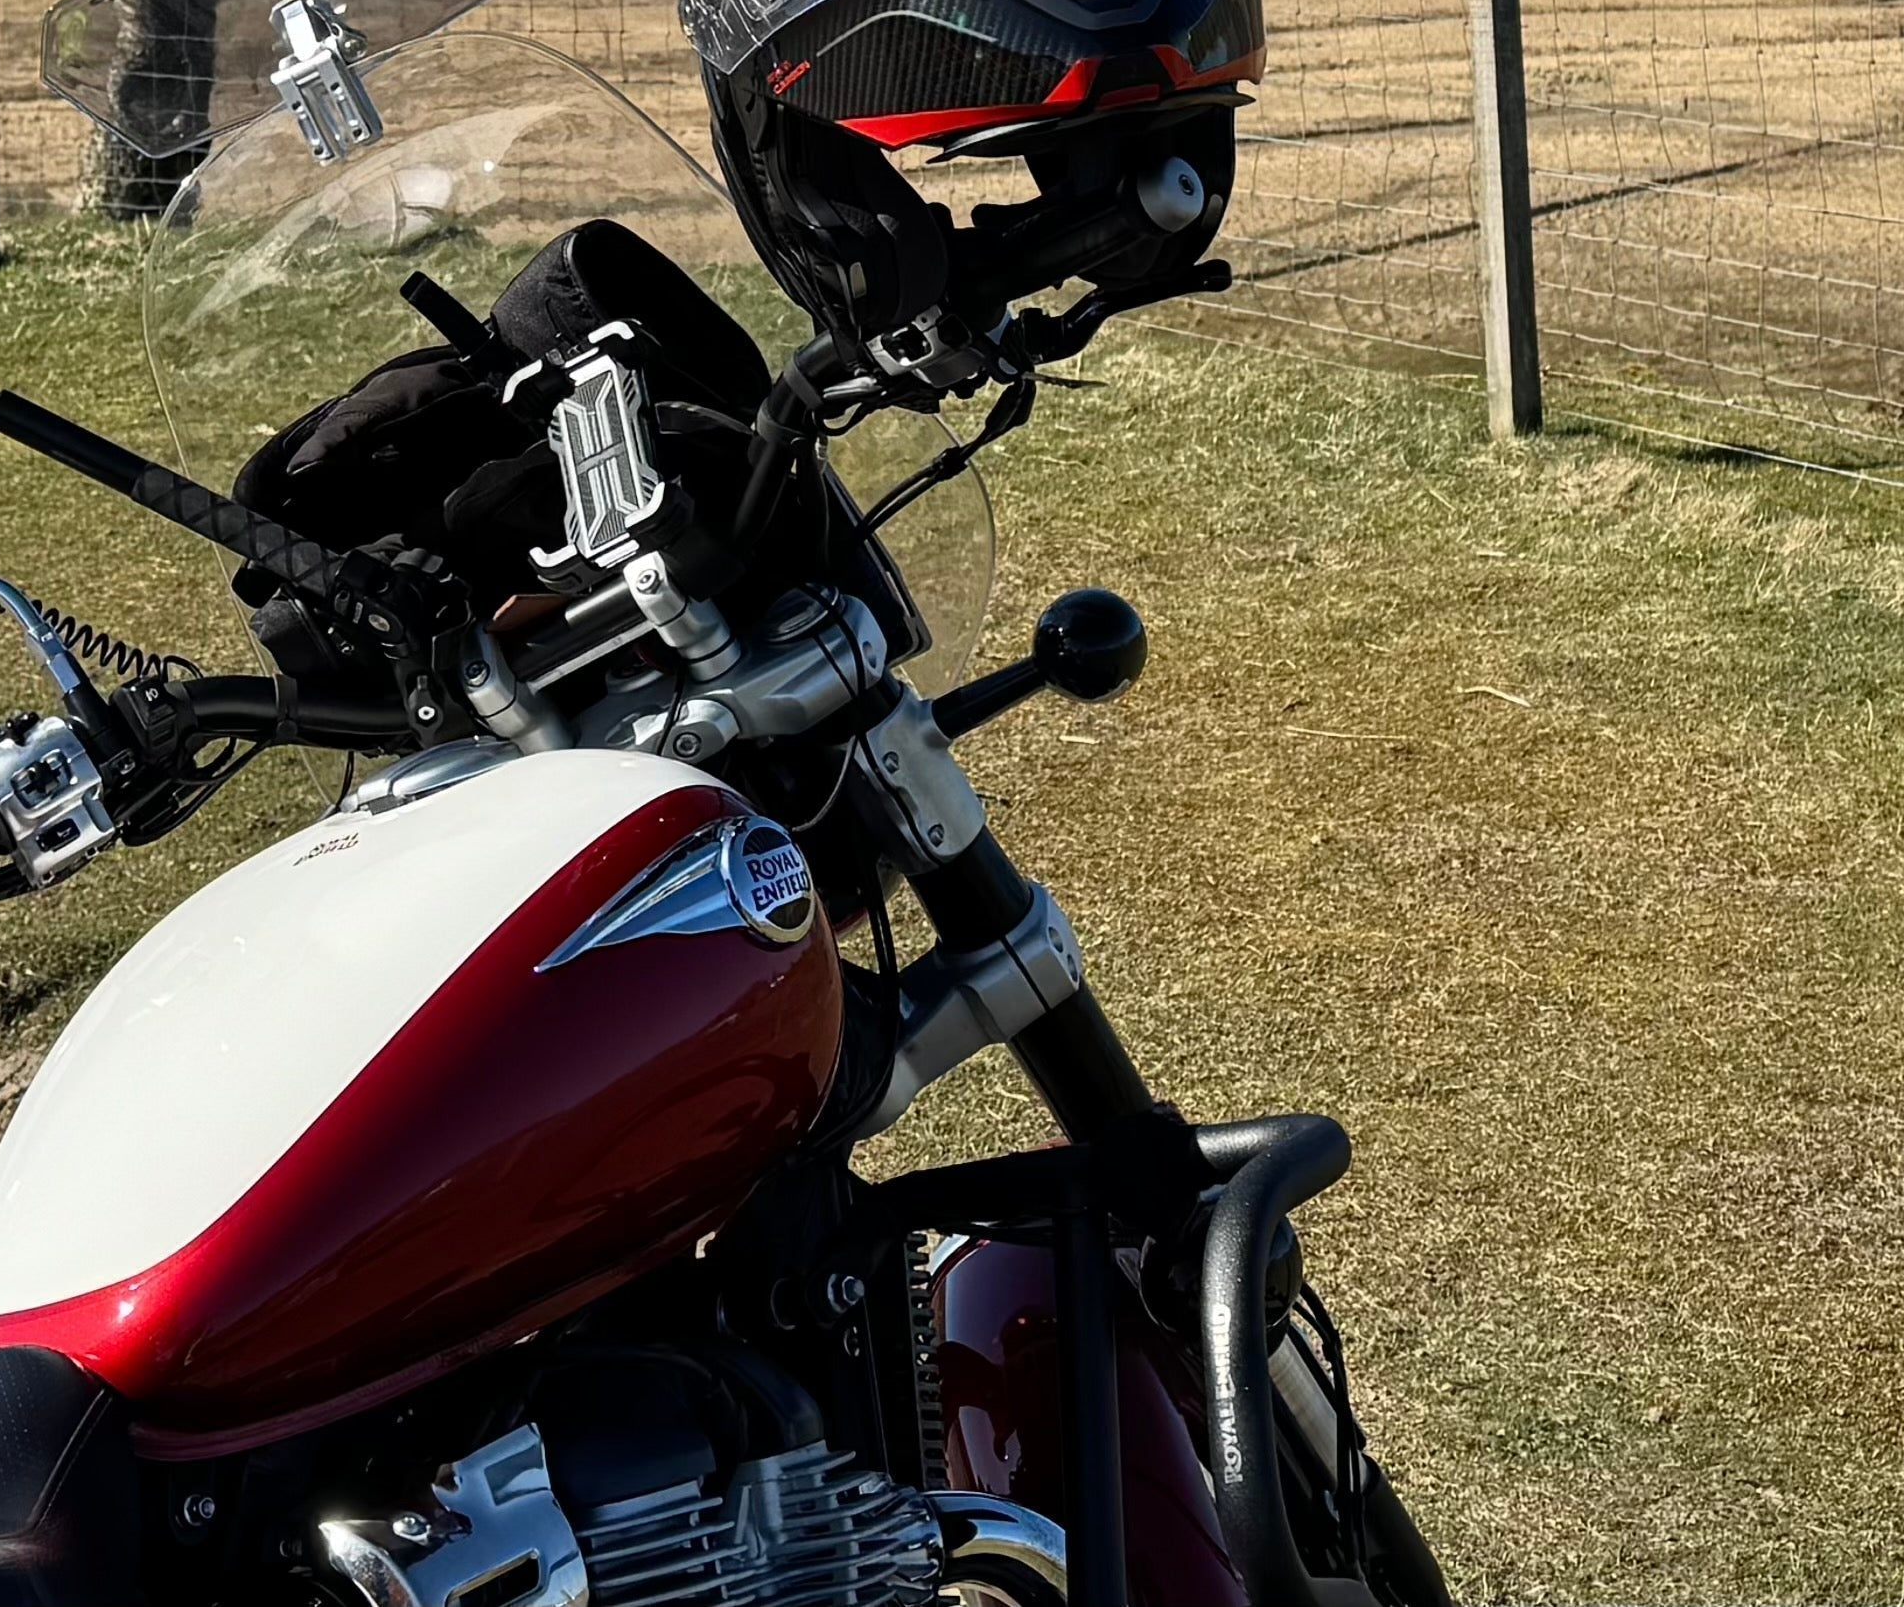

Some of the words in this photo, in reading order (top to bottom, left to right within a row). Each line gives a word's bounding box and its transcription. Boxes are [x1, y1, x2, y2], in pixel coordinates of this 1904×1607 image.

[745, 849, 801, 883] ROYAL
[751, 870, 810, 912] ENFIELD
[1212, 1303, 1236, 1400] ENFIELD
[1219, 1401, 1244, 1485] ROYAL
